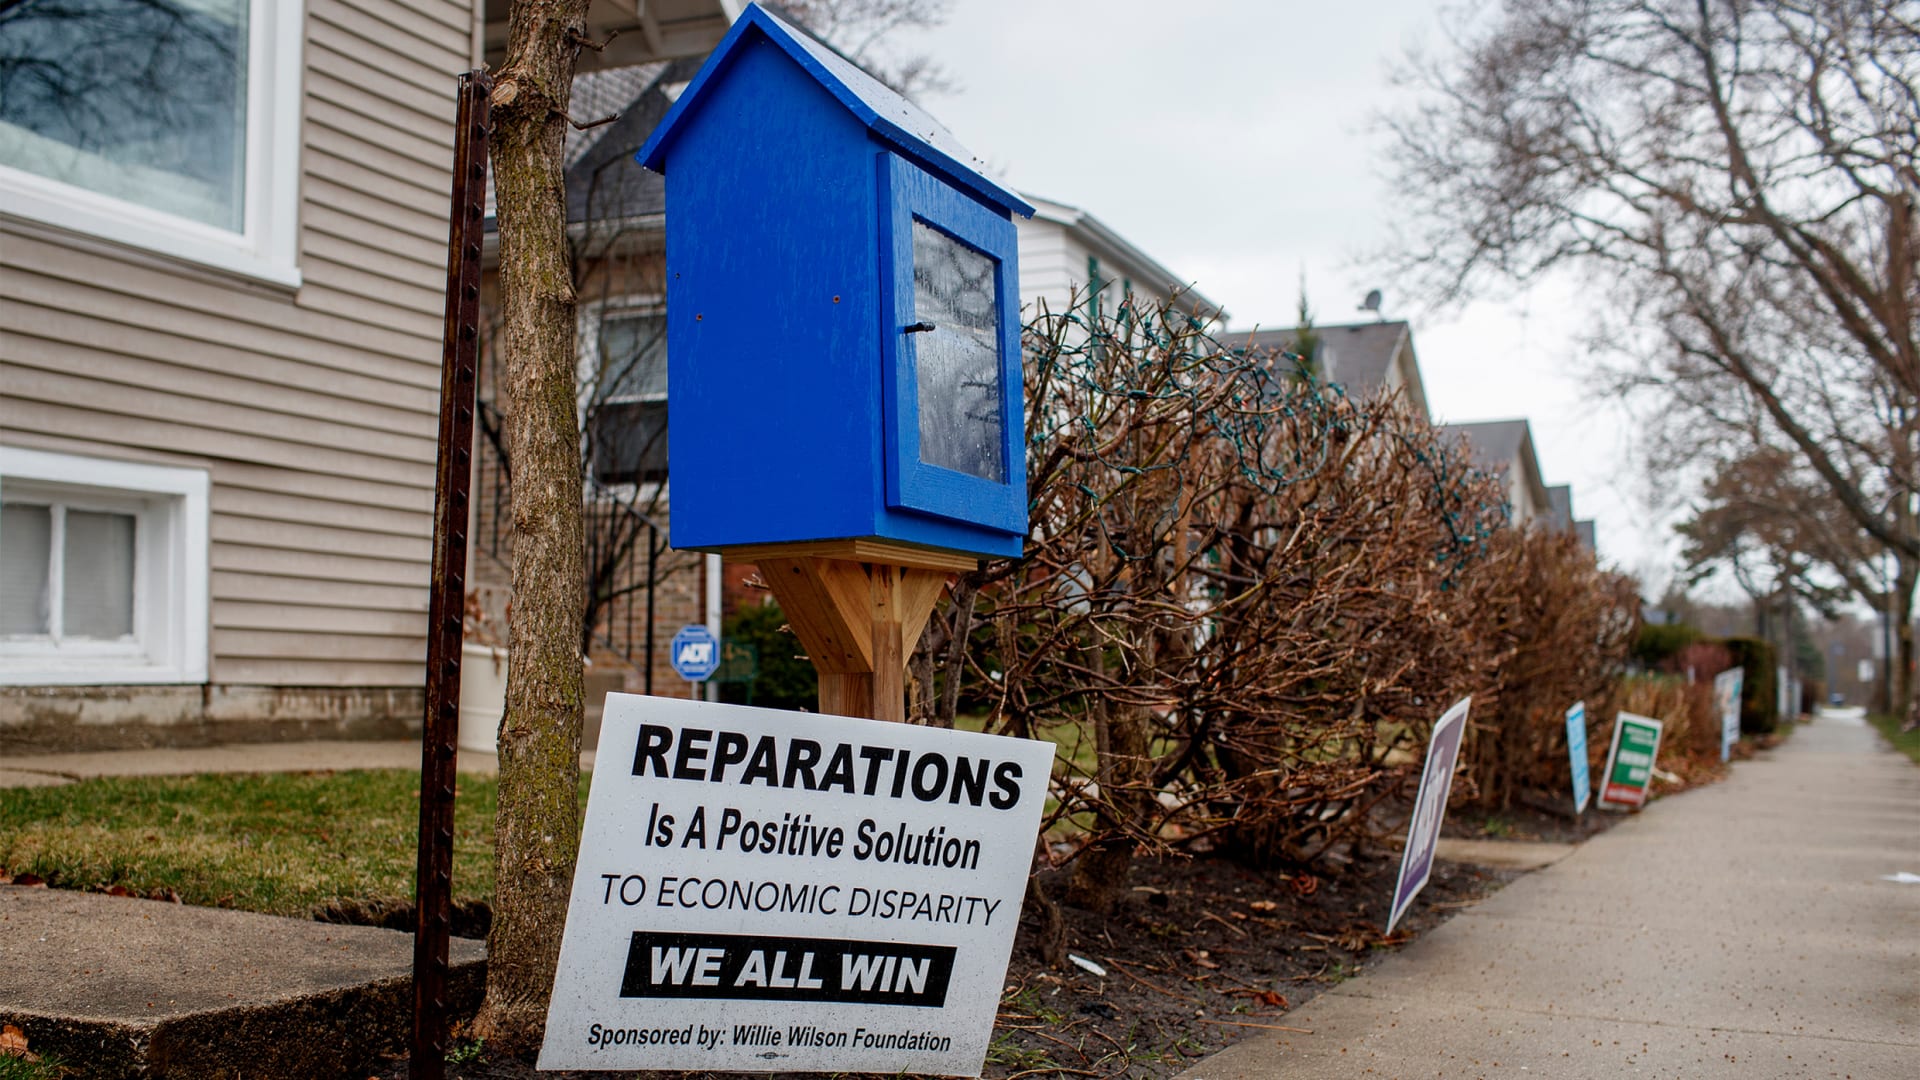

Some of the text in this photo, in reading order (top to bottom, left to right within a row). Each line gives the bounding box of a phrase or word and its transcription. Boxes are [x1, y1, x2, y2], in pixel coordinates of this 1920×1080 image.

[631, 723, 1024, 811] REPARATIONS
[644, 802, 981, 870] Is A Positive Solution
[600, 873, 1002, 927] TO ECONOMIC DISPARITY
[650, 946, 932, 995] WE ALL WIN
[587, 1023, 951, 1052] Sponsored by: Willie Wilson Foundation
